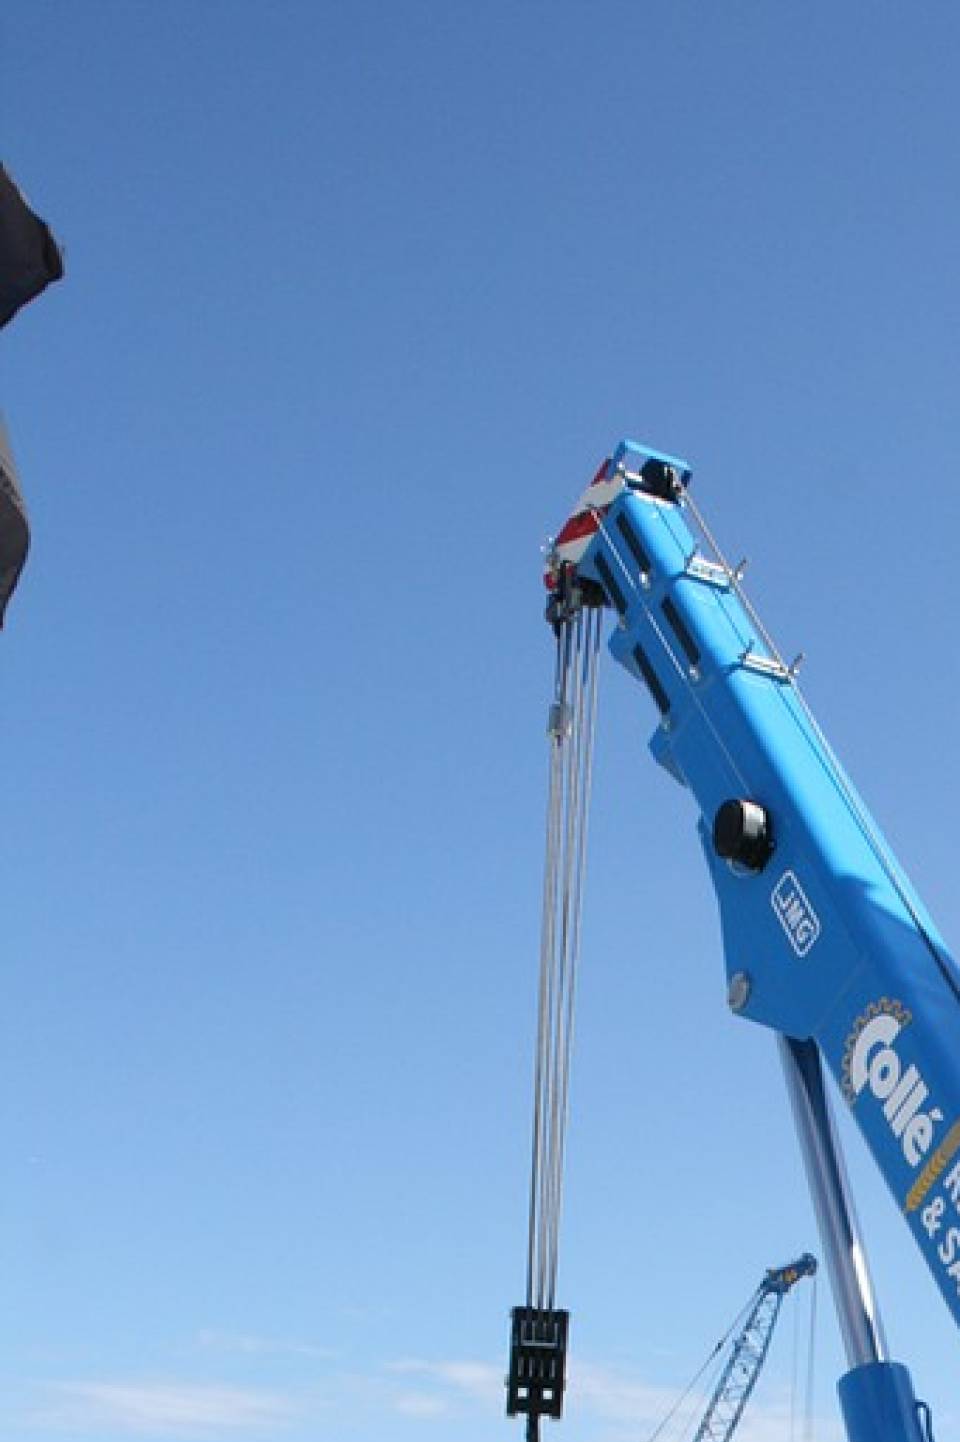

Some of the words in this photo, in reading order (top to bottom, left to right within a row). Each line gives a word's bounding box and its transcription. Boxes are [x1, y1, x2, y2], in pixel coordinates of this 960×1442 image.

[777, 889, 816, 944] JMG
[852, 1013, 945, 1169] Collé
[920, 1195, 946, 1241] &
